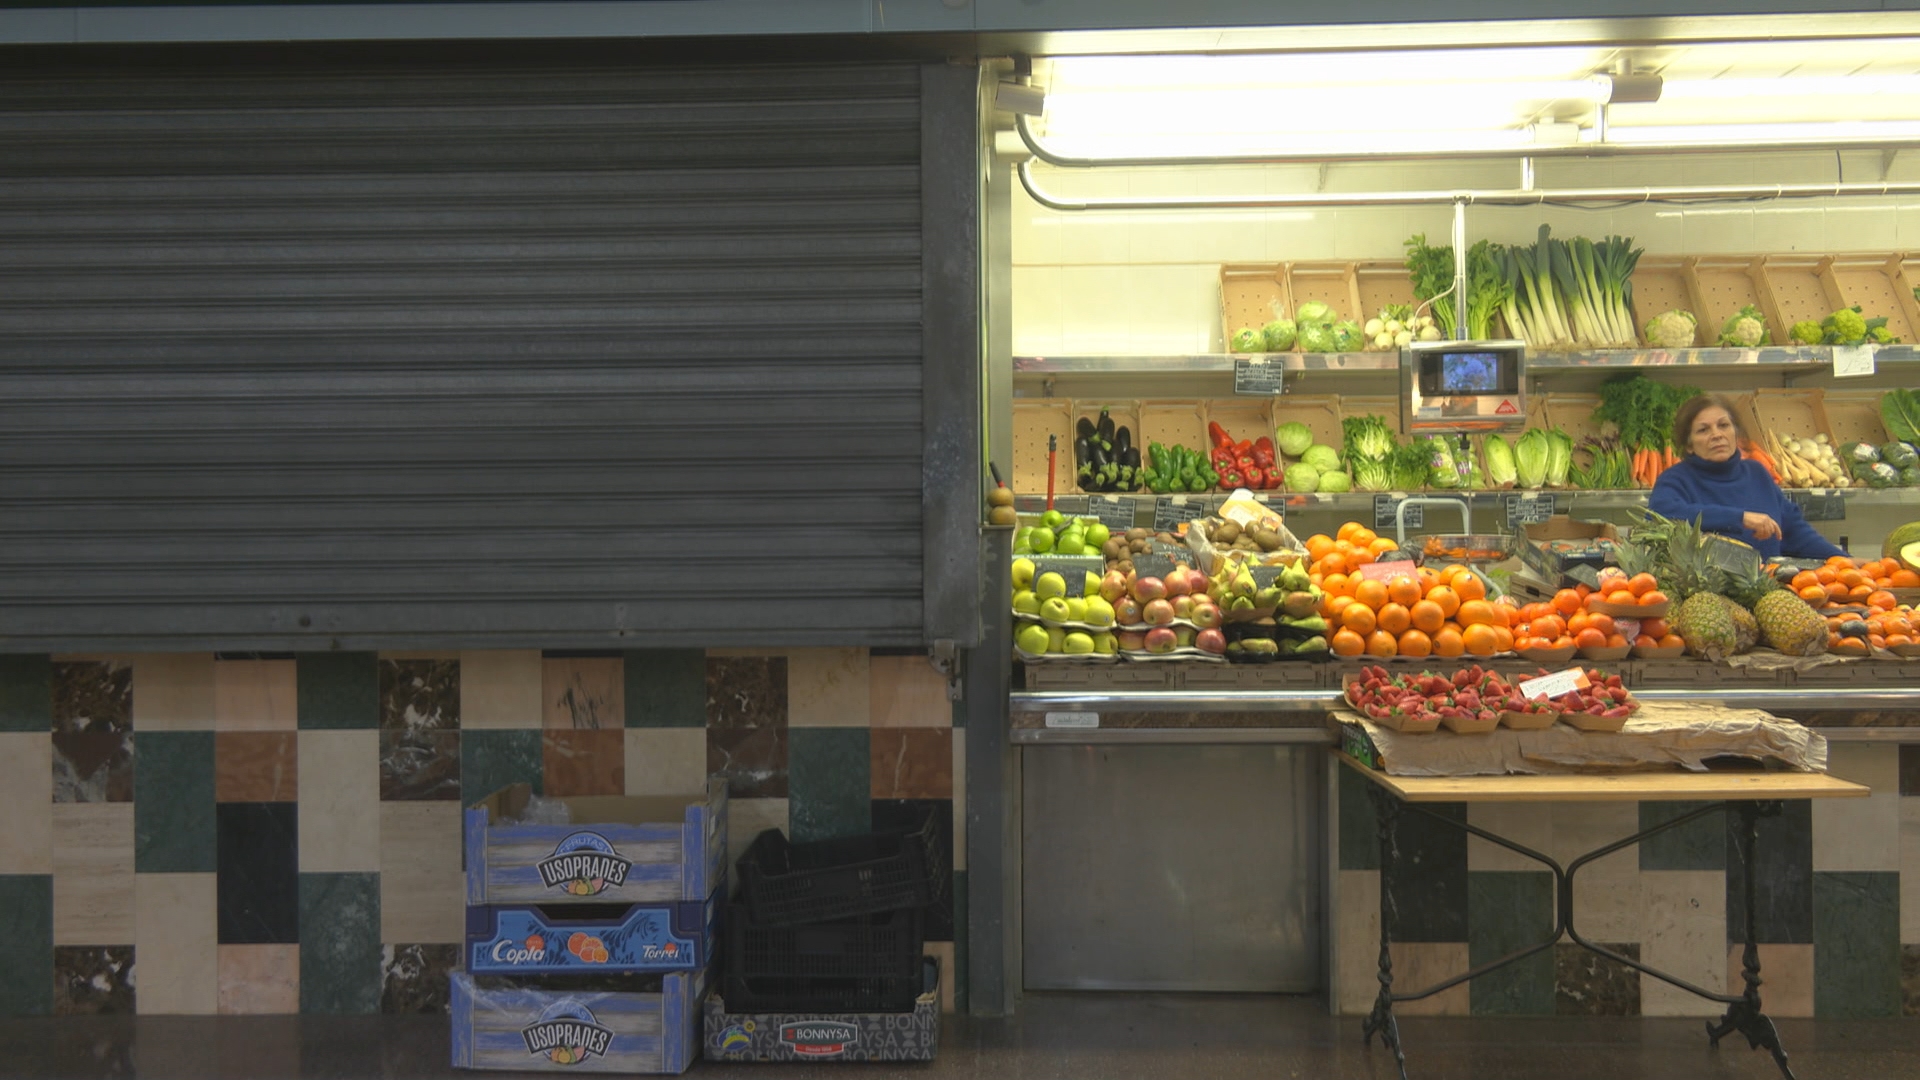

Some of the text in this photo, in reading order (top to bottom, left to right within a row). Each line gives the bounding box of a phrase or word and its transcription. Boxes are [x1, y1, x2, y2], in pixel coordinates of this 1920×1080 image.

[564, 837, 605, 850] FRUTAS
[543, 856, 626, 884] USOPRADES
[492, 940, 546, 965] Copla
[527, 1024, 607, 1053] USOPRADES
[796, 1028, 851, 1040] BONNYSA
